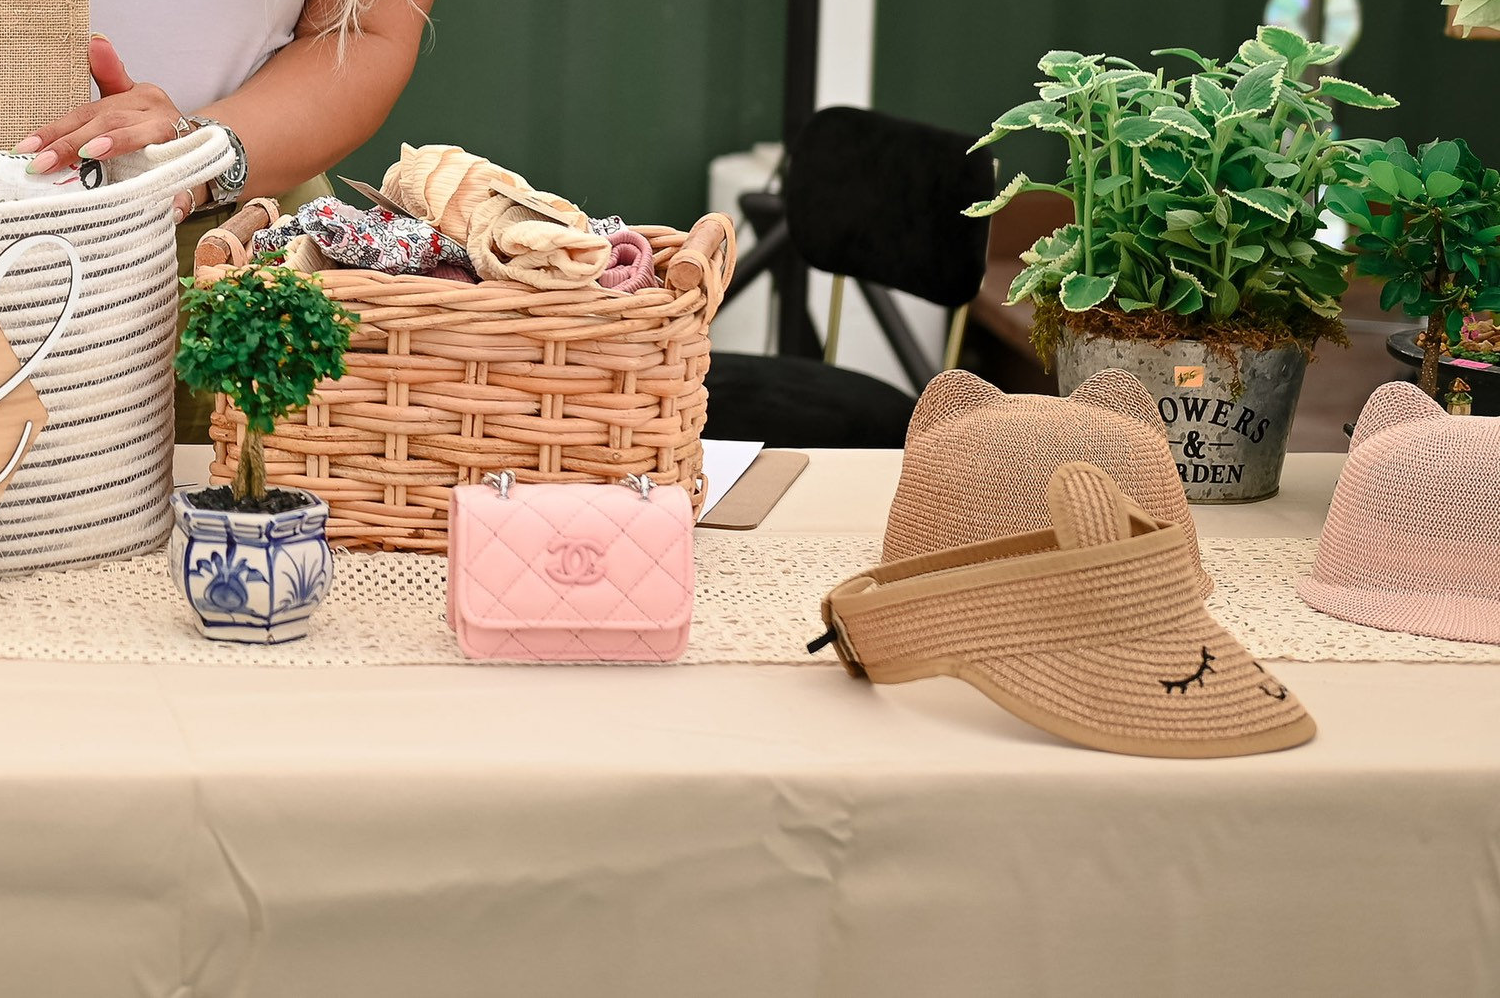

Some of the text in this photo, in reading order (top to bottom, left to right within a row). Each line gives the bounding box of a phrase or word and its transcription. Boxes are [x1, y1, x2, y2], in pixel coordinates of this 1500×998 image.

[1157, 396, 1271, 444] OWERS
[1183, 430, 1206, 459] &
[1176, 463, 1245, 484] RDEN
